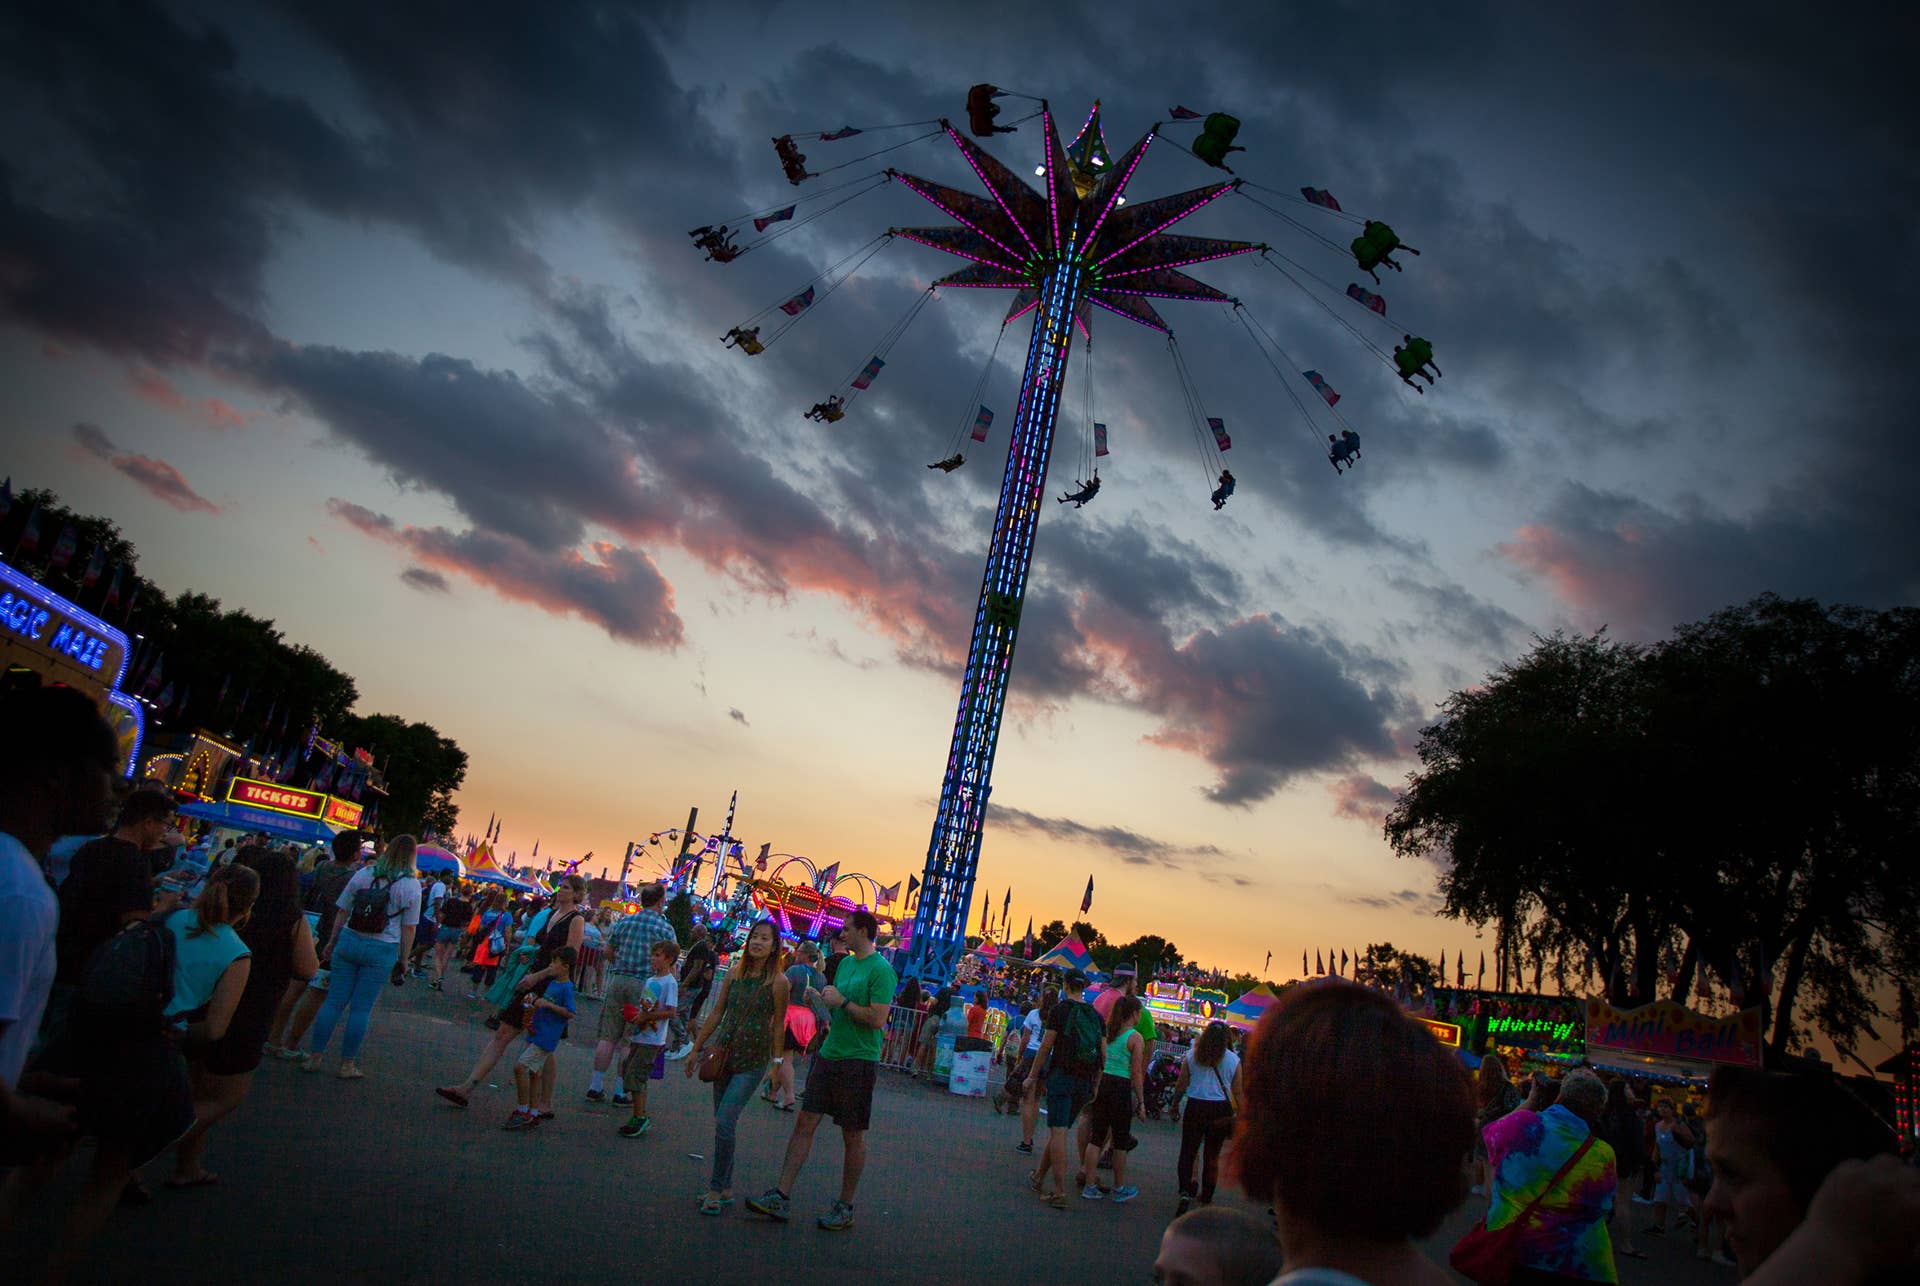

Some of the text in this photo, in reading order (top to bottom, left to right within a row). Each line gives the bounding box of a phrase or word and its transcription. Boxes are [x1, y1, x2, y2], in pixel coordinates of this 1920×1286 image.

[50, 622, 108, 670] MAZE
[246, 786, 308, 809] TICKETS
[1604, 1010, 1665, 1044] Mini
[1676, 1022, 1738, 1055] Ball
